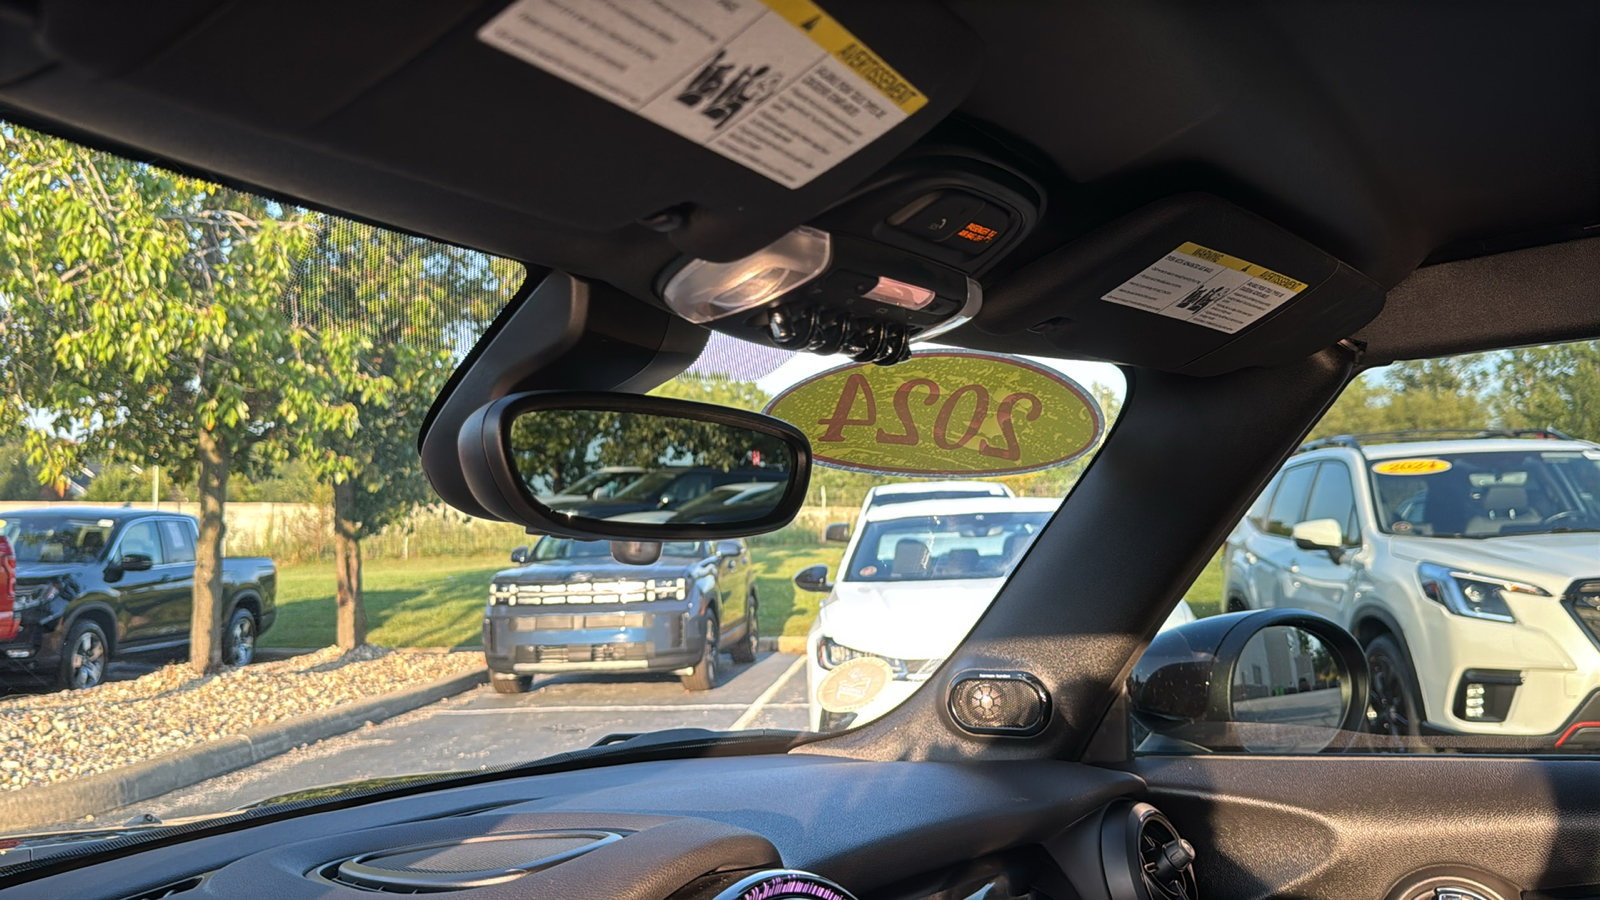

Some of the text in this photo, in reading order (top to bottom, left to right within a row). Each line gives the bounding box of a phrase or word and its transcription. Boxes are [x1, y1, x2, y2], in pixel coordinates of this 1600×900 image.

[839, 43, 917, 106] AVERTISSEMENT
[1191, 247, 1224, 263] WARNING
[1260, 270, 1303, 291] AVERTISSEMENT
[1387, 461, 1437, 473] 2024
